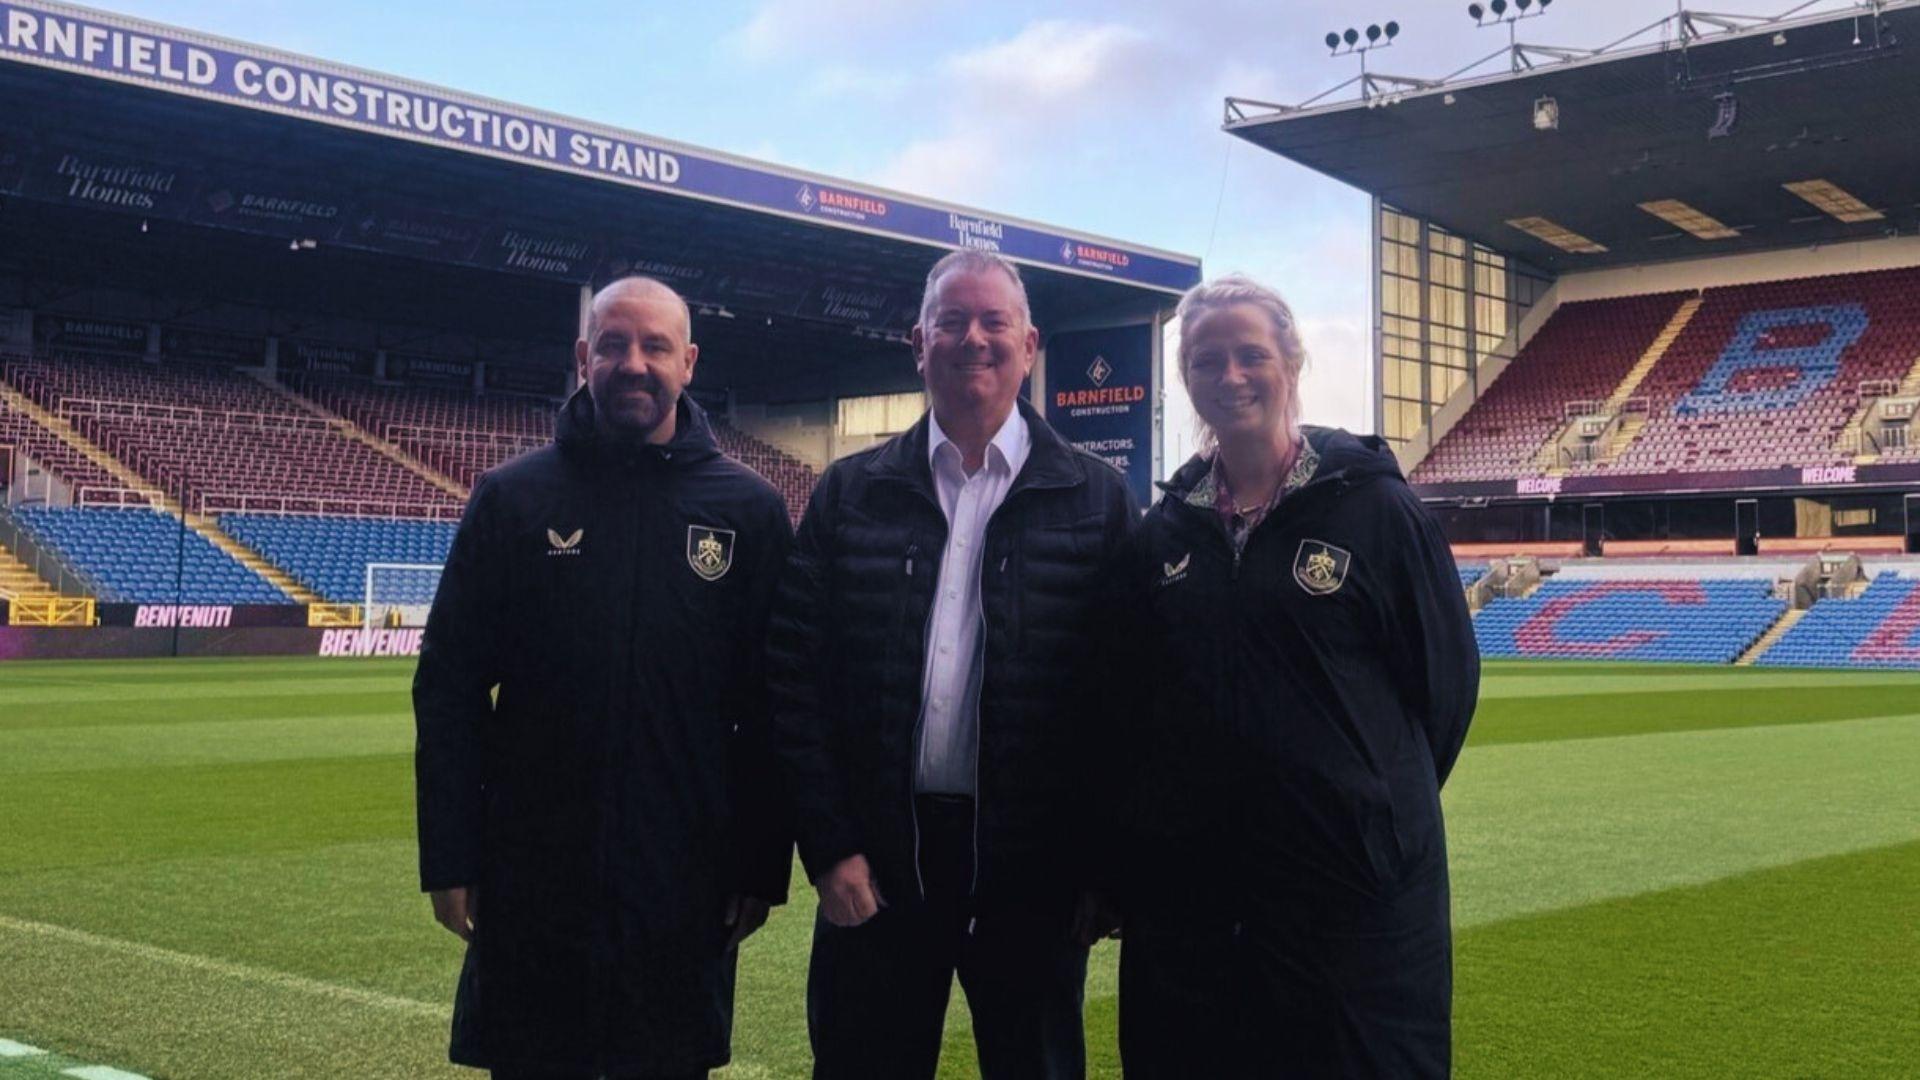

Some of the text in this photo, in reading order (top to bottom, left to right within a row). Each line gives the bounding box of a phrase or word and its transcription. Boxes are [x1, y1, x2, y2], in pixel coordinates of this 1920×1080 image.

[0, 9, 680, 184] RNFIELD CONSTRUCTION STAND
[57, 154, 176, 193] Barnfield
[69, 176, 153, 208] Homes
[818, 191, 886, 216] BARNFIELD
[241, 193, 338, 218] BARNFIELD
[949, 213, 1003, 239] Barnfield
[959, 231, 1000, 252] Homes
[1077, 245, 1129, 267] BARNFIELD
[1056, 386, 1145, 407] BARNFIELD
[1070, 404, 1130, 417] CONSTRUCTION
[1517, 478, 1563, 493] WELCOME
[1802, 466, 1857, 484] WELCOME
[135, 605, 233, 628] BENVENUTI
[319, 628, 425, 656] BIENVENUE
